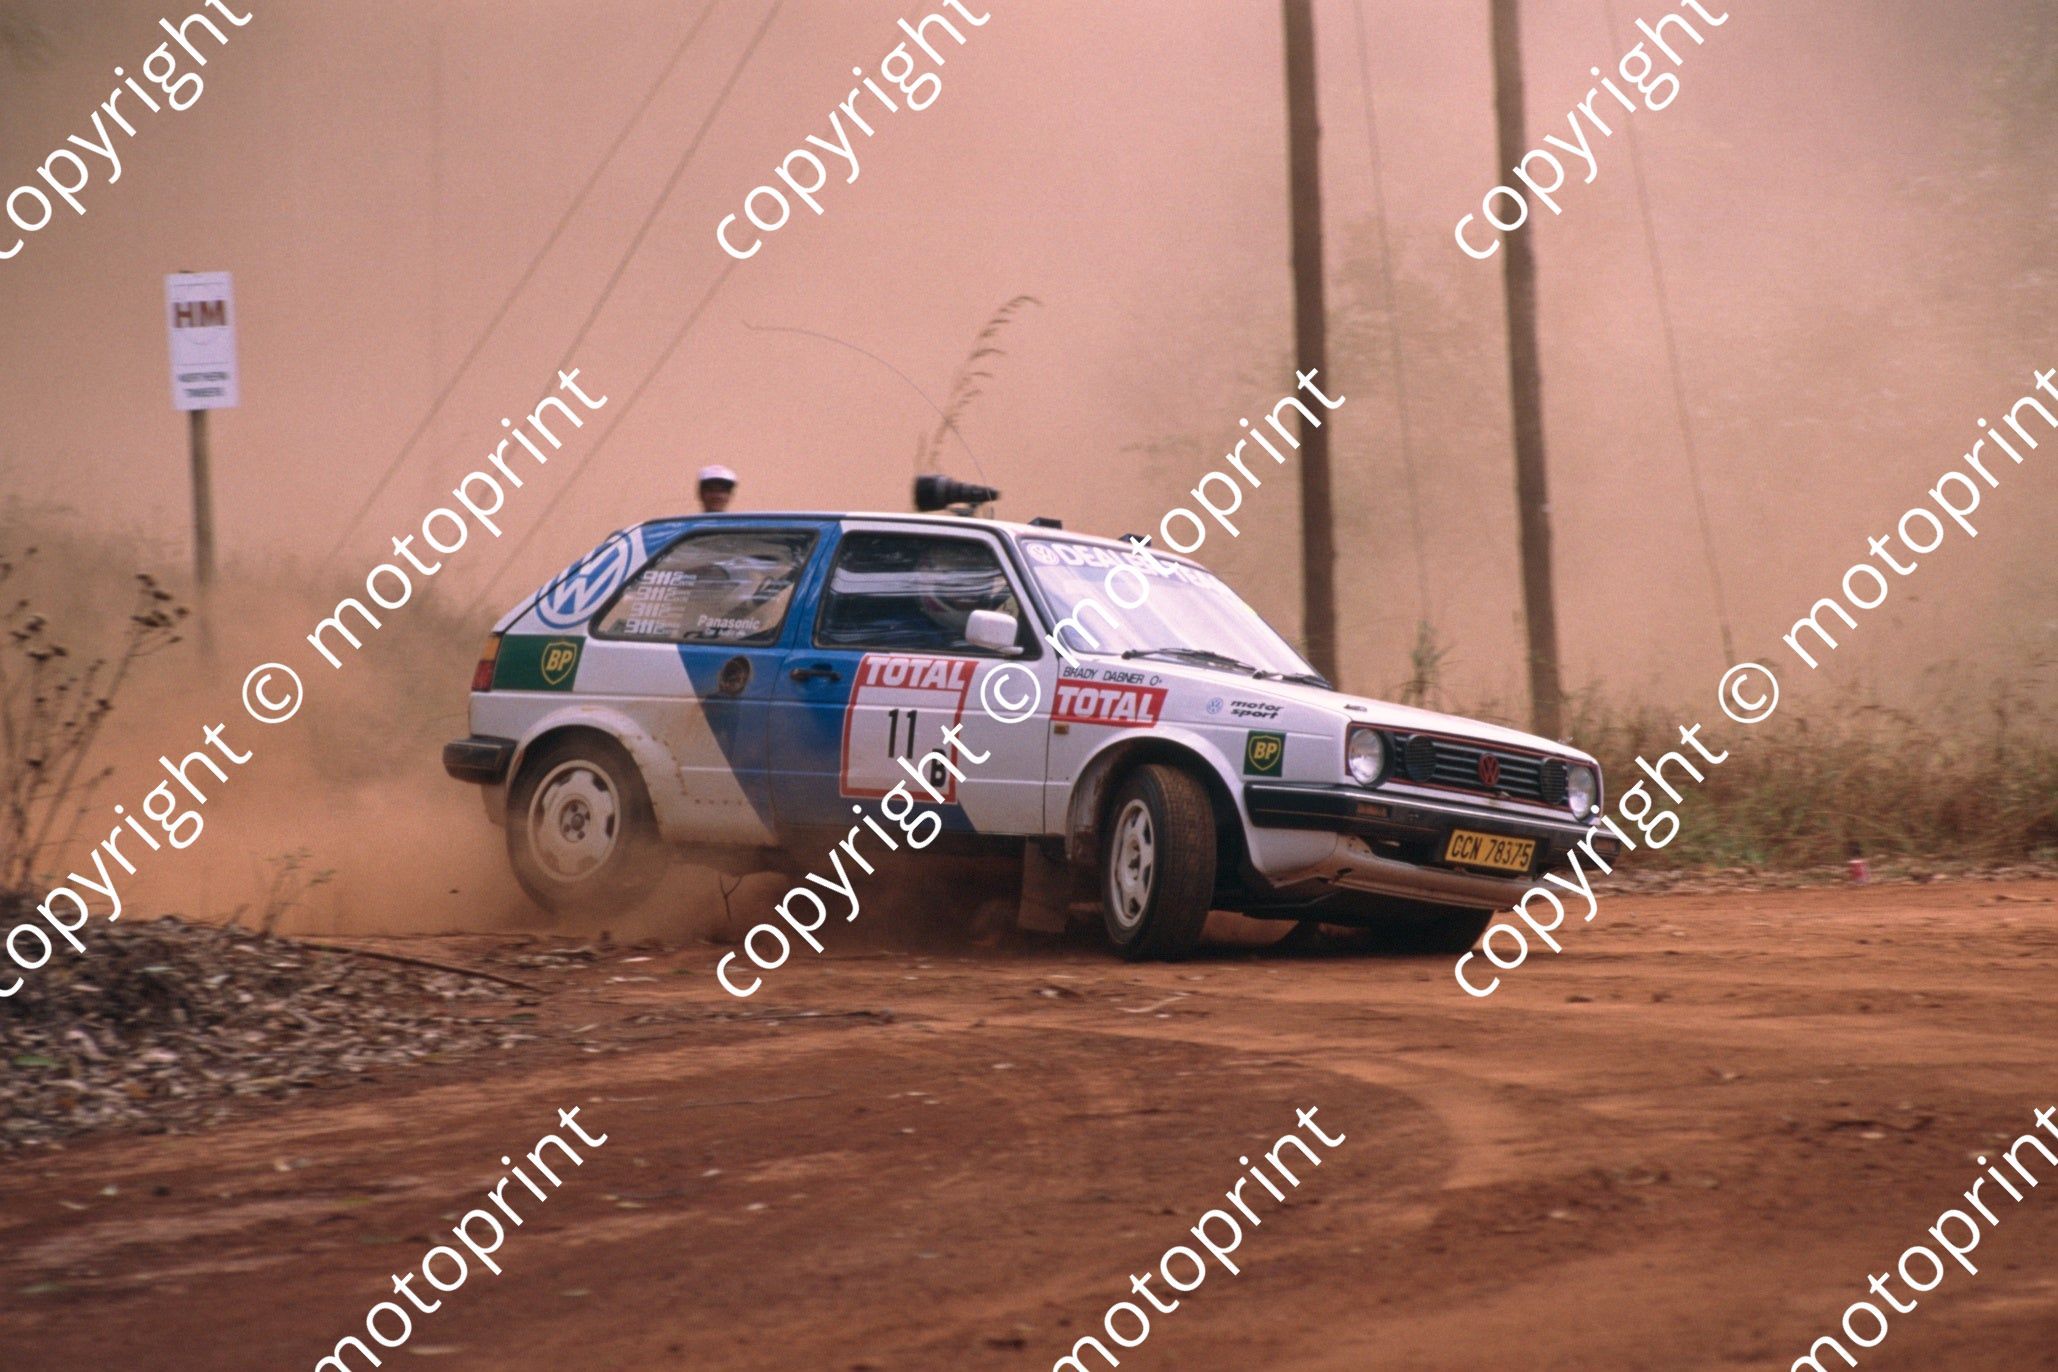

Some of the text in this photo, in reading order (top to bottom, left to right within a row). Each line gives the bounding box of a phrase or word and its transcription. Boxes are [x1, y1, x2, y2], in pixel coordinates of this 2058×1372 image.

[173, 300, 227, 328] HM
[697, 614, 761, 630] Panasonic
[546, 650, 573, 671] BP
[865, 656, 967, 690] TOTAL
[1063, 667, 1098, 680] BRADY
[1103, 671, 1145, 684] DABNER
[1057, 685, 1154, 724] TOTAL
[1231, 700, 1284, 712] motor
[1231, 708, 1279, 719] sport
[888, 709, 918, 760] 11
[1253, 741, 1279, 760] BP
[1451, 834, 1533, 868] CCN 78375
